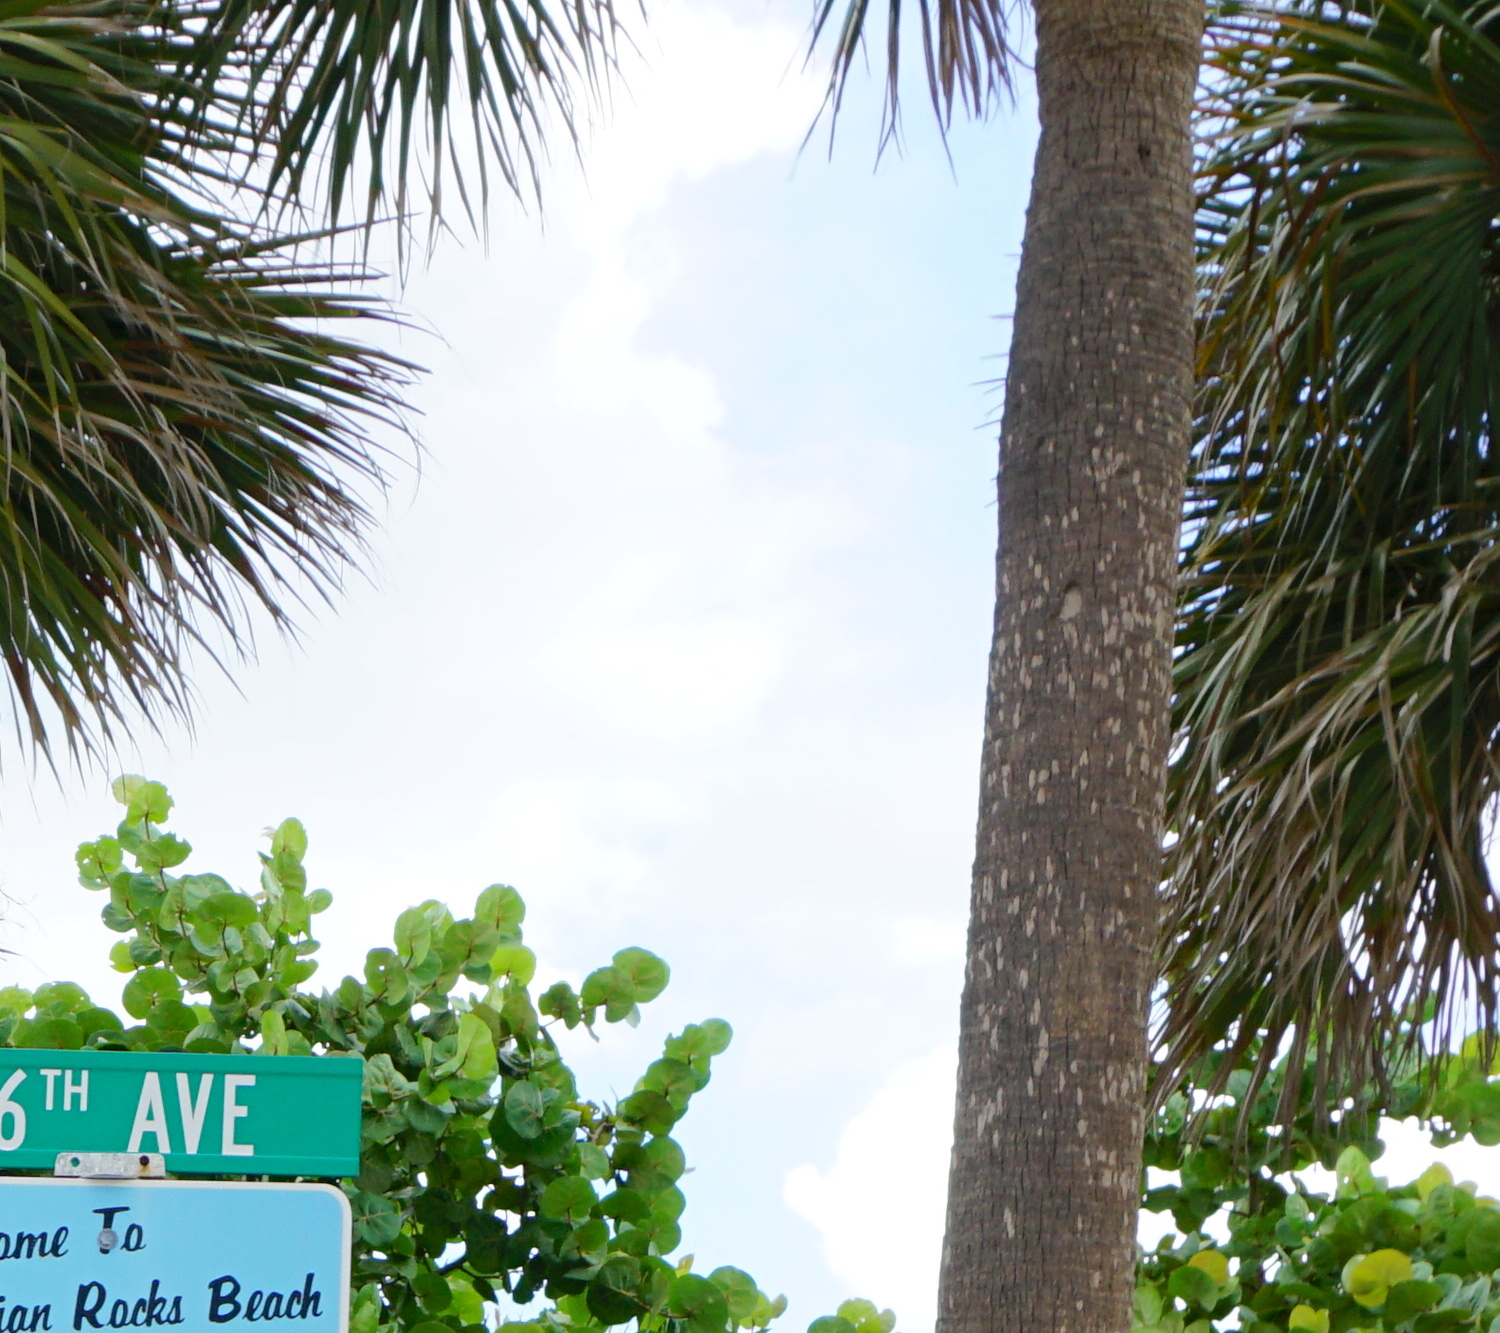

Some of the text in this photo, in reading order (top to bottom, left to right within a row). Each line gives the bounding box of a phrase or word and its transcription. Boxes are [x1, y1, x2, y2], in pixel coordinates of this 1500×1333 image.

[127, 1071, 257, 1157] AVE
[92, 1206, 147, 1254] To
[72, 1279, 185, 1332] Rocks
[207, 1272, 323, 1324] Beach
